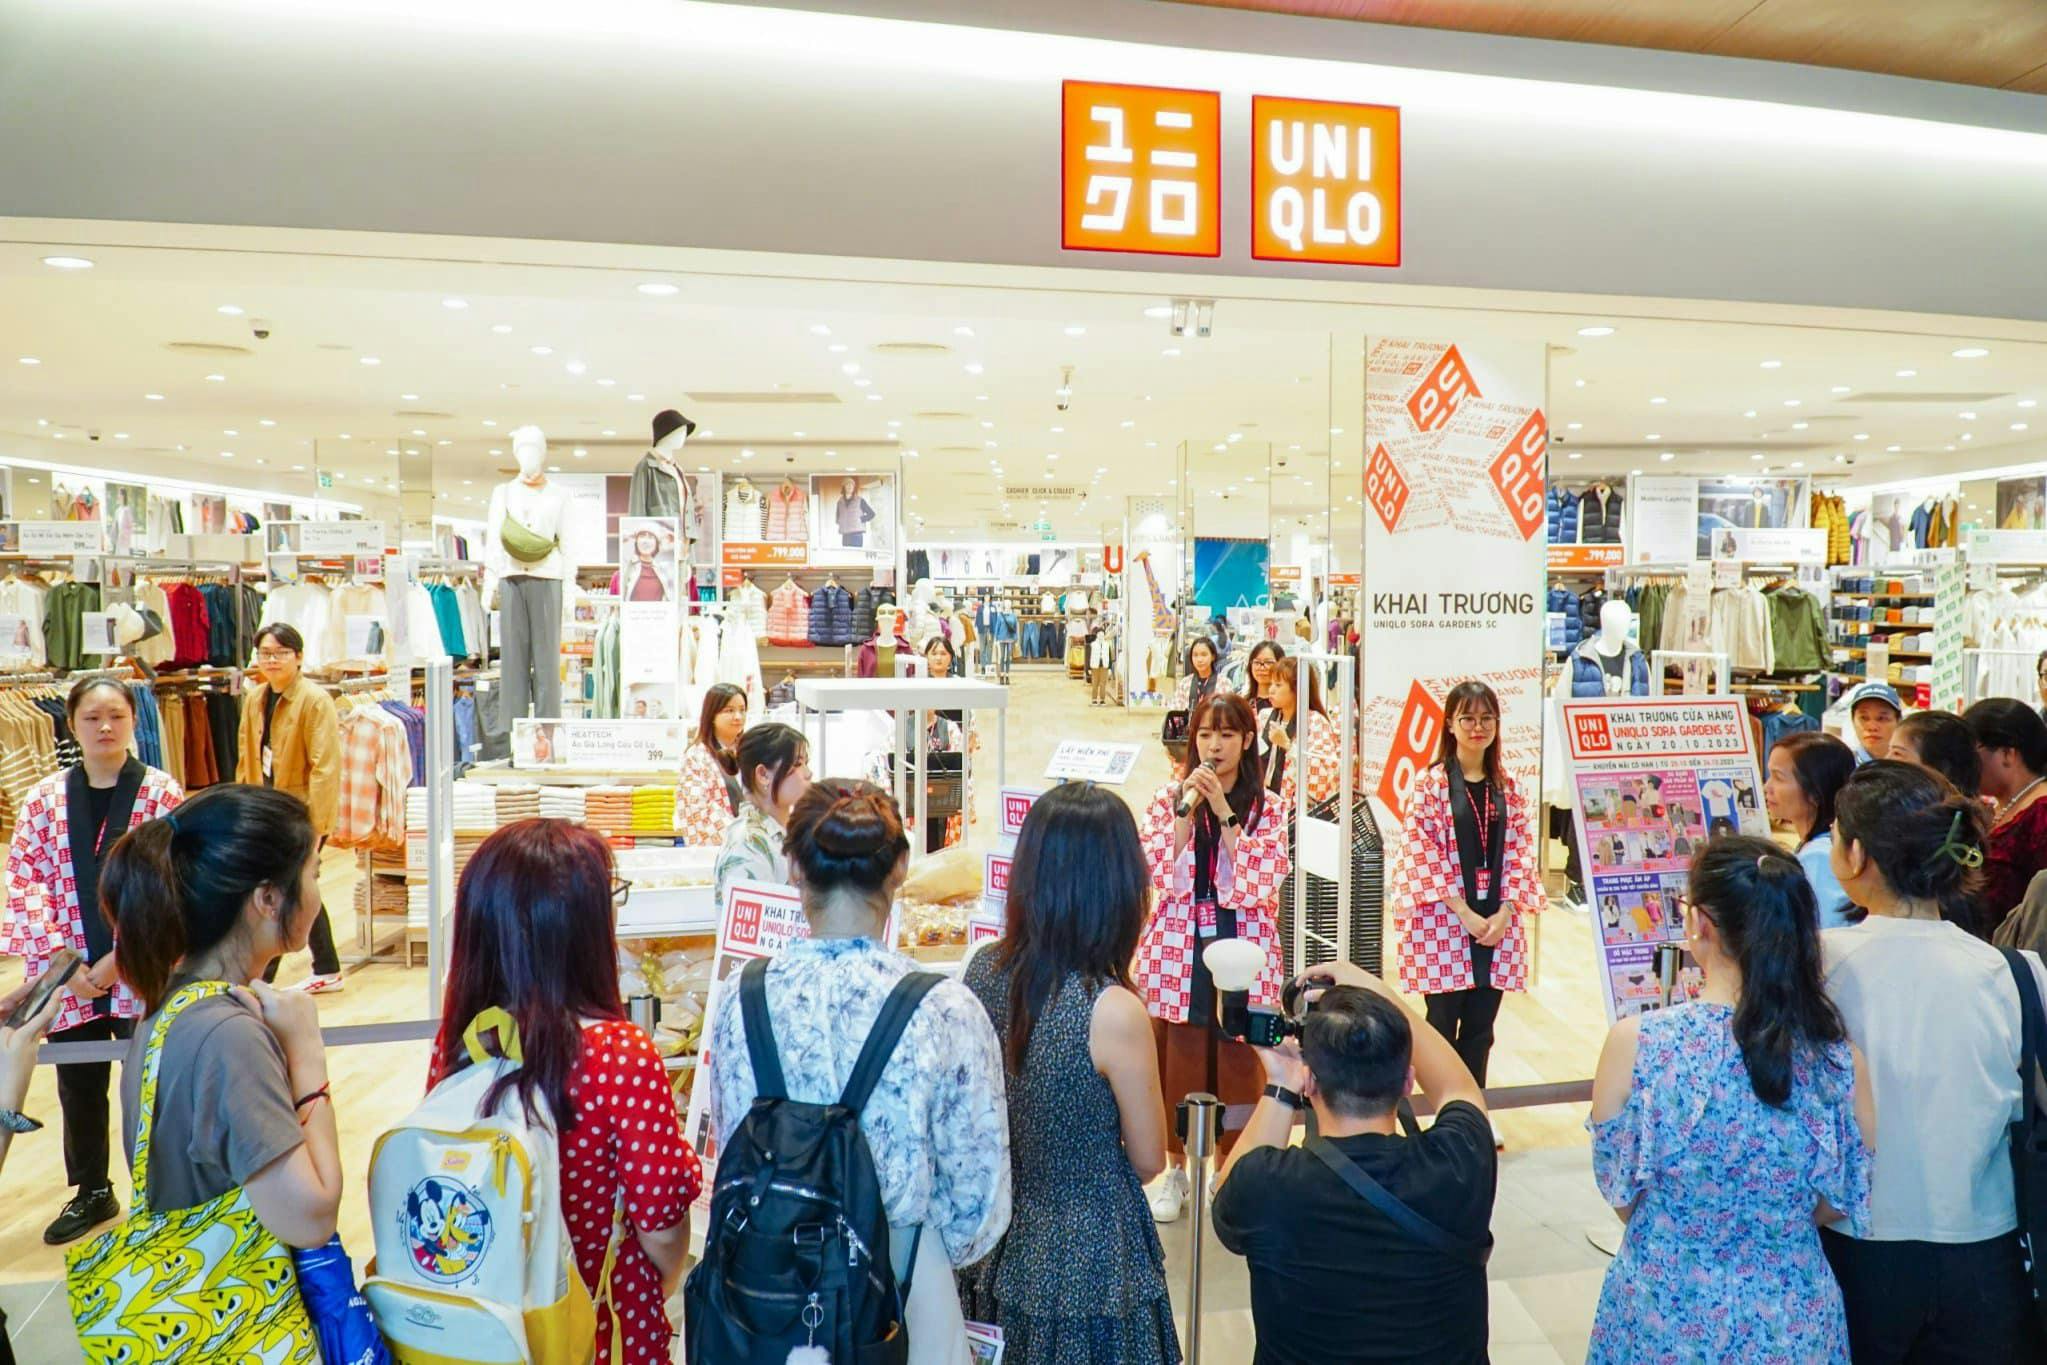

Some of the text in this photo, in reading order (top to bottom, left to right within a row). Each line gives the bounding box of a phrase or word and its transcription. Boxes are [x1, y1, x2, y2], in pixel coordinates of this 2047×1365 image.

[1270, 119, 1371, 181] UNI
[1270, 185, 1381, 251] QLO
[1521, 423, 1546, 481] UN
[1375, 453, 1403, 501] UNI
[1501, 453, 1543, 521] QLO
[1368, 473, 1396, 521] QLO
[1373, 591, 1533, 615] KHAI TRƯƠNG
[1373, 620, 1497, 629] UNIQLO SORA GARDENS SC
[1579, 719, 1604, 732] UNI
[1610, 711, 1635, 723] KHAI
[571, 730, 612, 738] HEATTECH
[1613, 724, 1737, 739] UNIQLO SORA GARDENS SC
[1582, 735, 1608, 748] QLO
[648, 750, 663, 761] 399
[993, 863, 1007, 875] UN
[993, 875, 1007, 888] QL
[736, 904, 757, 922] UNI
[763, 904, 786, 920] KHAI
[733, 921, 756, 939] QLO
[762, 919, 793, 937] UNIQLO
